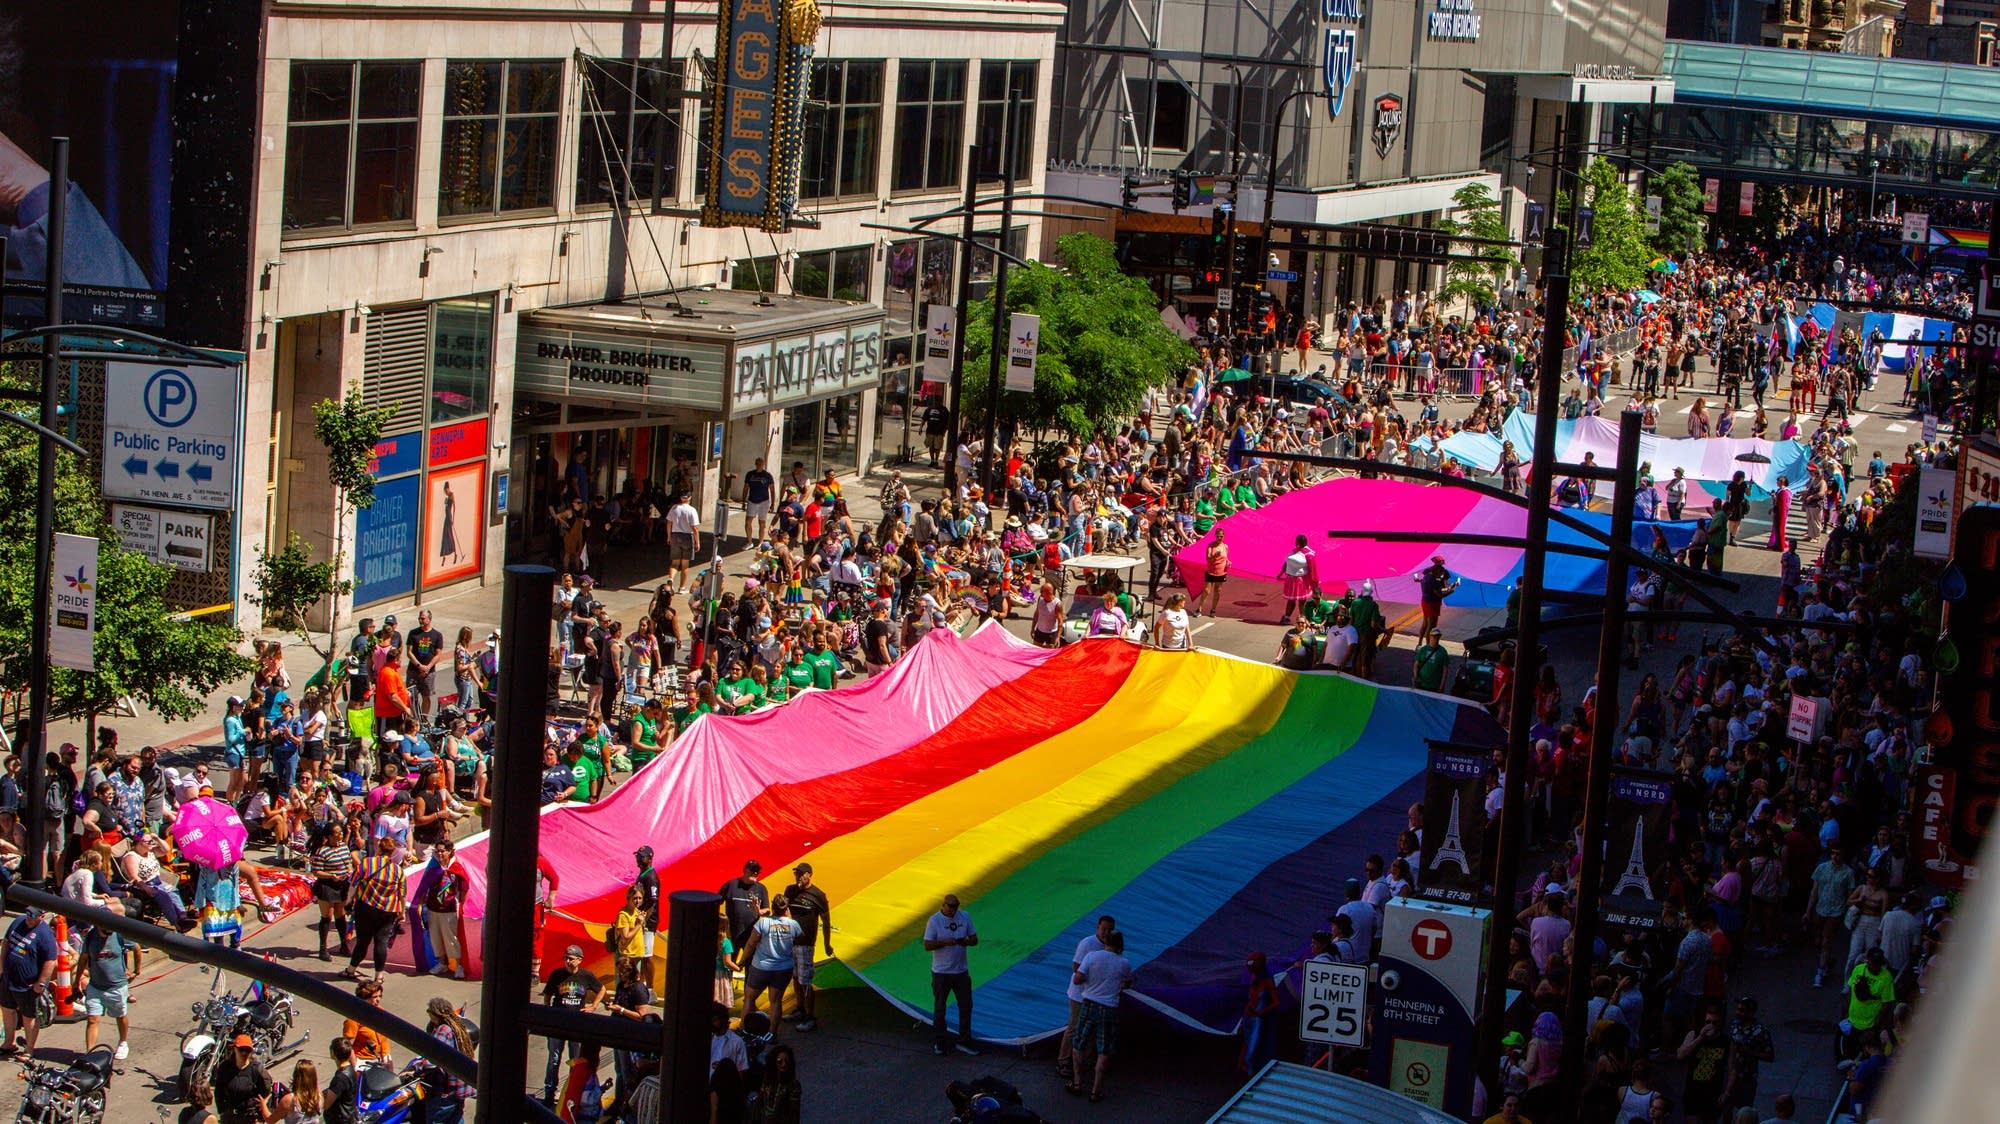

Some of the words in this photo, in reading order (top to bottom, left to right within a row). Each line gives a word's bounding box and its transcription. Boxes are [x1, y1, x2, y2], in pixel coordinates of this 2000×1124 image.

[1431, 11, 1452, 37] SPORTS
[1452, 14, 1481, 38] MEDICINE
[88, 289, 110, 297] Portrait
[929, 338, 949, 346] PRIDE
[538, 342, 609, 365] BRAVER,
[609, 350, 697, 374] BRIGHTER,
[1012, 347, 1033, 355] PRIDE
[737, 331, 879, 402] PANTAGES
[158, 379, 186, 418] P
[113, 431, 160, 452] Public
[167, 436, 226, 461] Parking
[139, 489, 150, 497] 714
[122, 510, 153, 522] SPECIAL
[370, 495, 403, 527] BRAVER
[1921, 509, 1947, 519] PRIDE
[165, 522, 204, 540] PARK
[363, 522, 407, 557] BRIGHTER
[364, 551, 403, 586] BOLDER
[57, 594, 89, 608] PRIDE
[1797, 703, 1809, 714] NO
[1791, 712, 1813, 726] STOPPING
[1436, 762, 1448, 771] DU
[1450, 763, 1480, 775] NORD
[1619, 788, 1632, 796] DU
[1635, 789, 1666, 800] NORD
[1923, 774, 1945, 841] CAFE
[179, 828, 204, 848] SHADE
[218, 838, 233, 865] SHADE
[1423, 887, 1445, 898] JUNE
[1447, 889, 1471, 901] 27-30
[1605, 914, 1627, 925] JUNE
[1629, 916, 1655, 928] 27-30
[1417, 927, 1447, 956] T
[1309, 970, 1362, 988] SPEED
[1313, 987, 1355, 1004] LIMIT
[1384, 998, 1437, 1013] HENNEPIN
[1437, 1006, 1446, 1015] &
[1306, 1004, 1358, 1036] 25
[1383, 1010, 1404, 1021] 8TH
[1405, 1013, 1441, 1025] STREET
[1404, 1087, 1430, 1097] STATION
